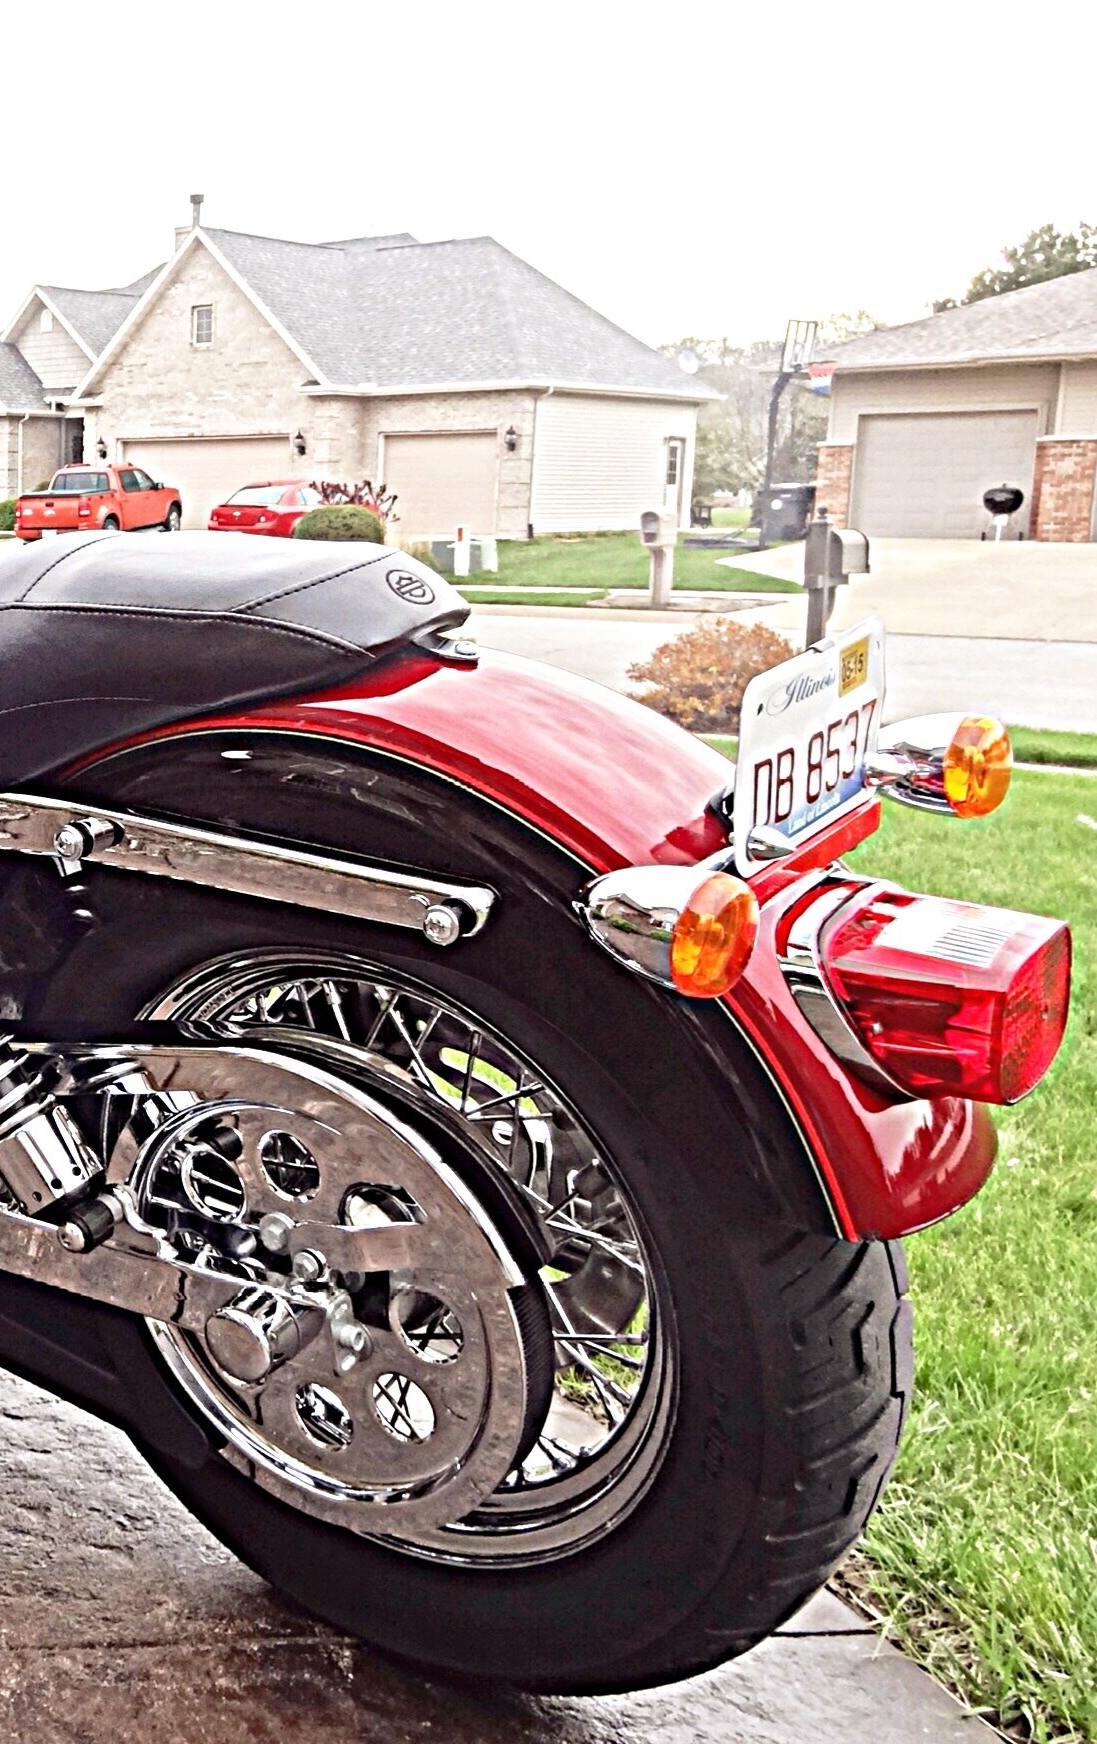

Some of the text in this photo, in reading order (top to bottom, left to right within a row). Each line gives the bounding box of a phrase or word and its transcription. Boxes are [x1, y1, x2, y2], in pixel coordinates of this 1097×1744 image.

[765, 667, 836, 716] Illinois
[753, 698, 877, 827] DB 8537
